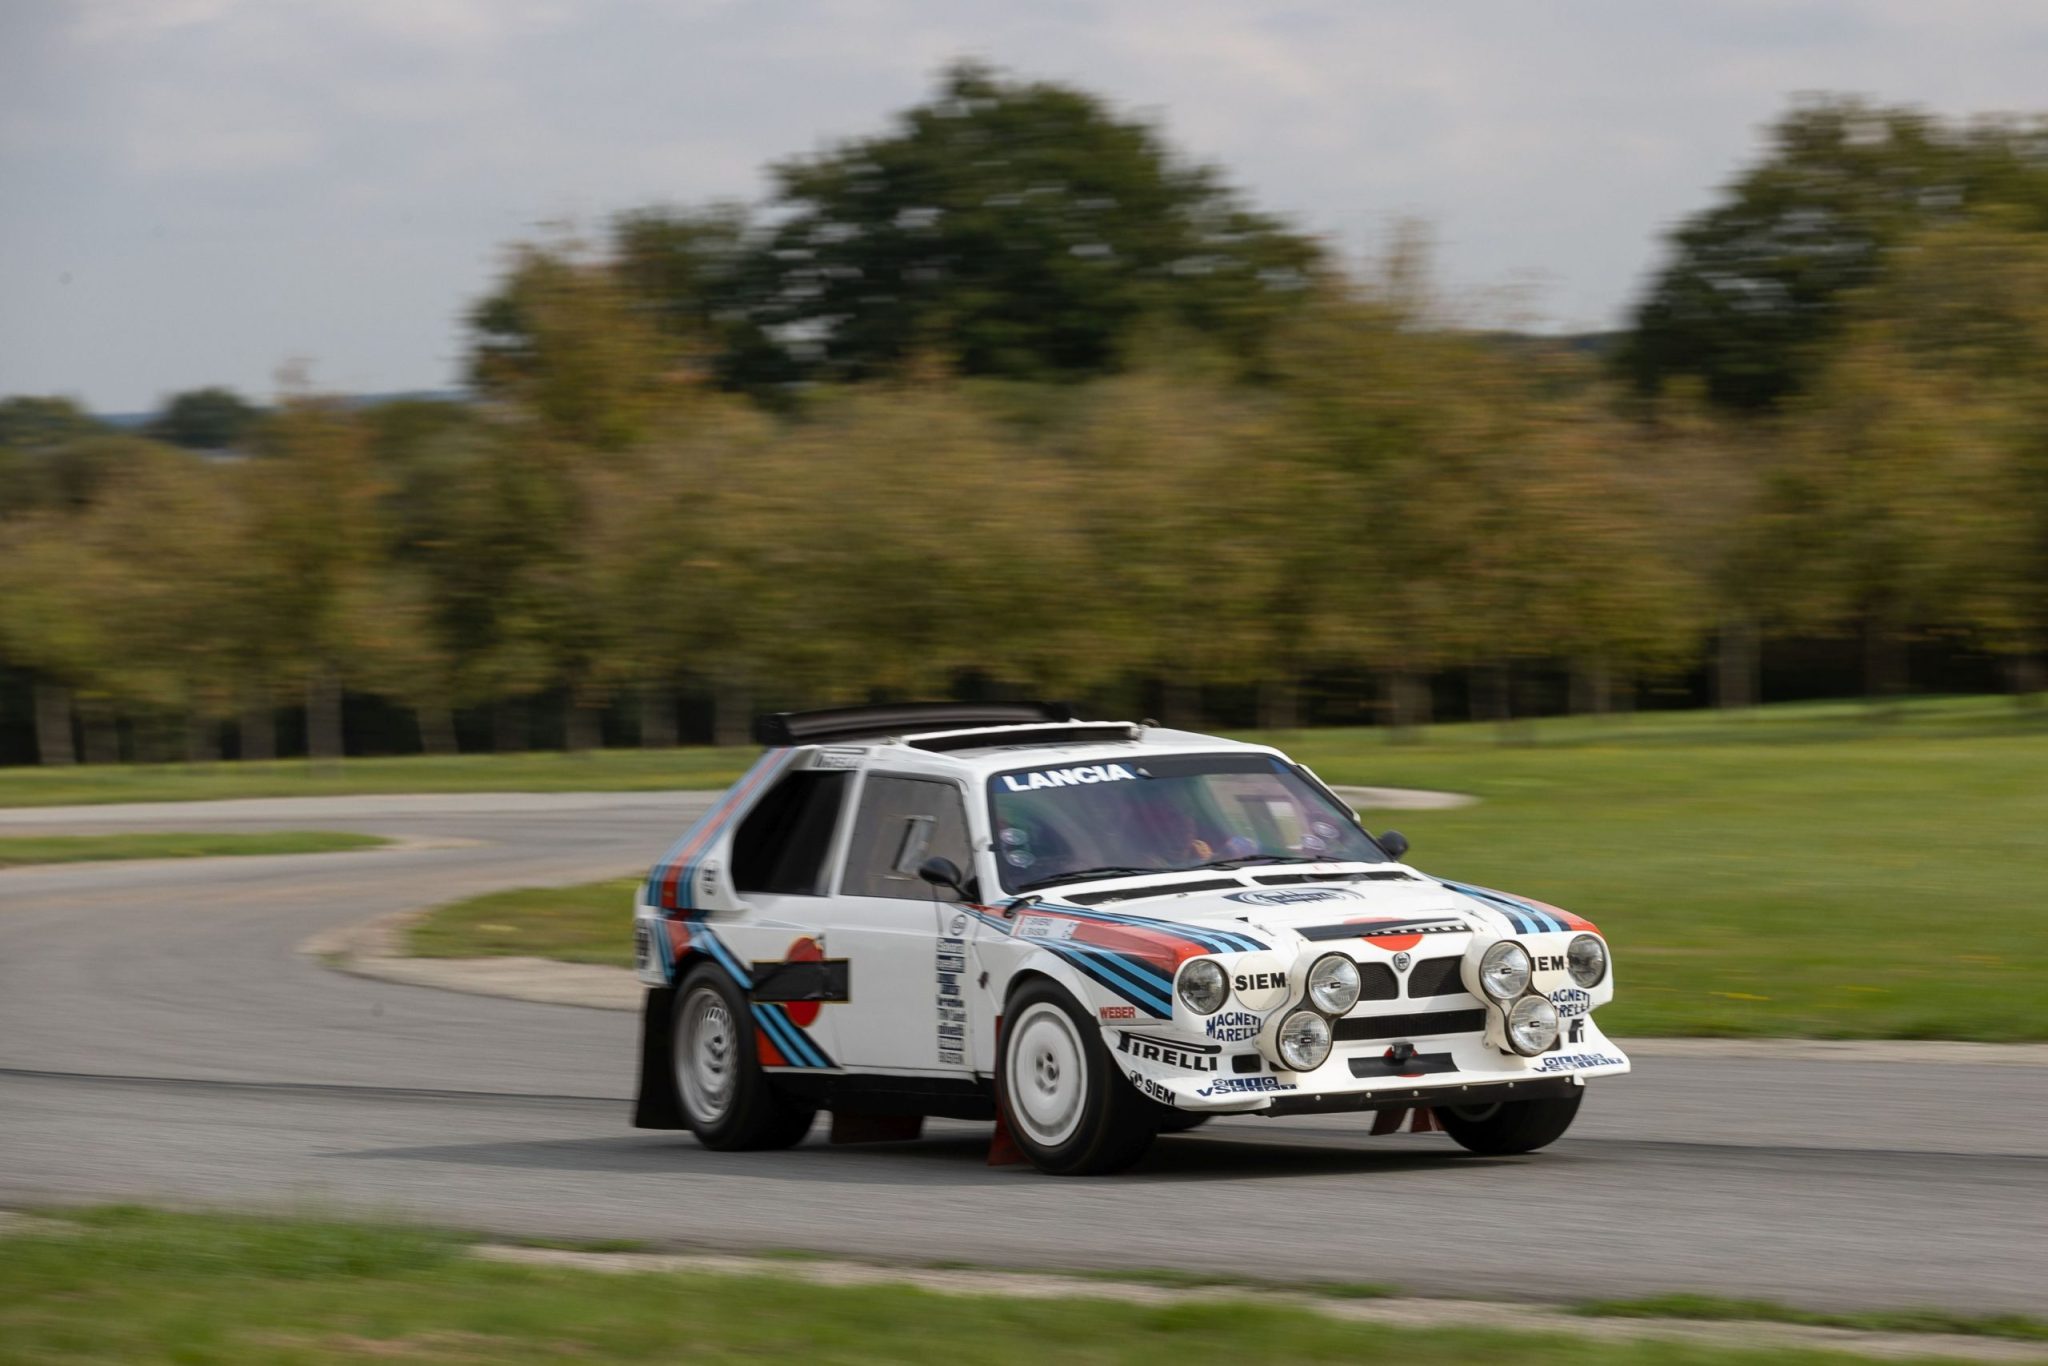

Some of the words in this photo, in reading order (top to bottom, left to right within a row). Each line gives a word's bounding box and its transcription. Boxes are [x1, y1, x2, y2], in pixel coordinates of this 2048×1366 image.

[1001, 763, 1137, 792] LANCIA
[1530, 955, 1565, 972] IEM
[1234, 971, 1287, 991] SIEM
[1099, 1006, 1136, 1019] WEBER
[1206, 1011, 1262, 1030] MAGNETI
[1117, 1029, 1223, 1072] PIRELLI
[1145, 1079, 1177, 1106] SIEM
